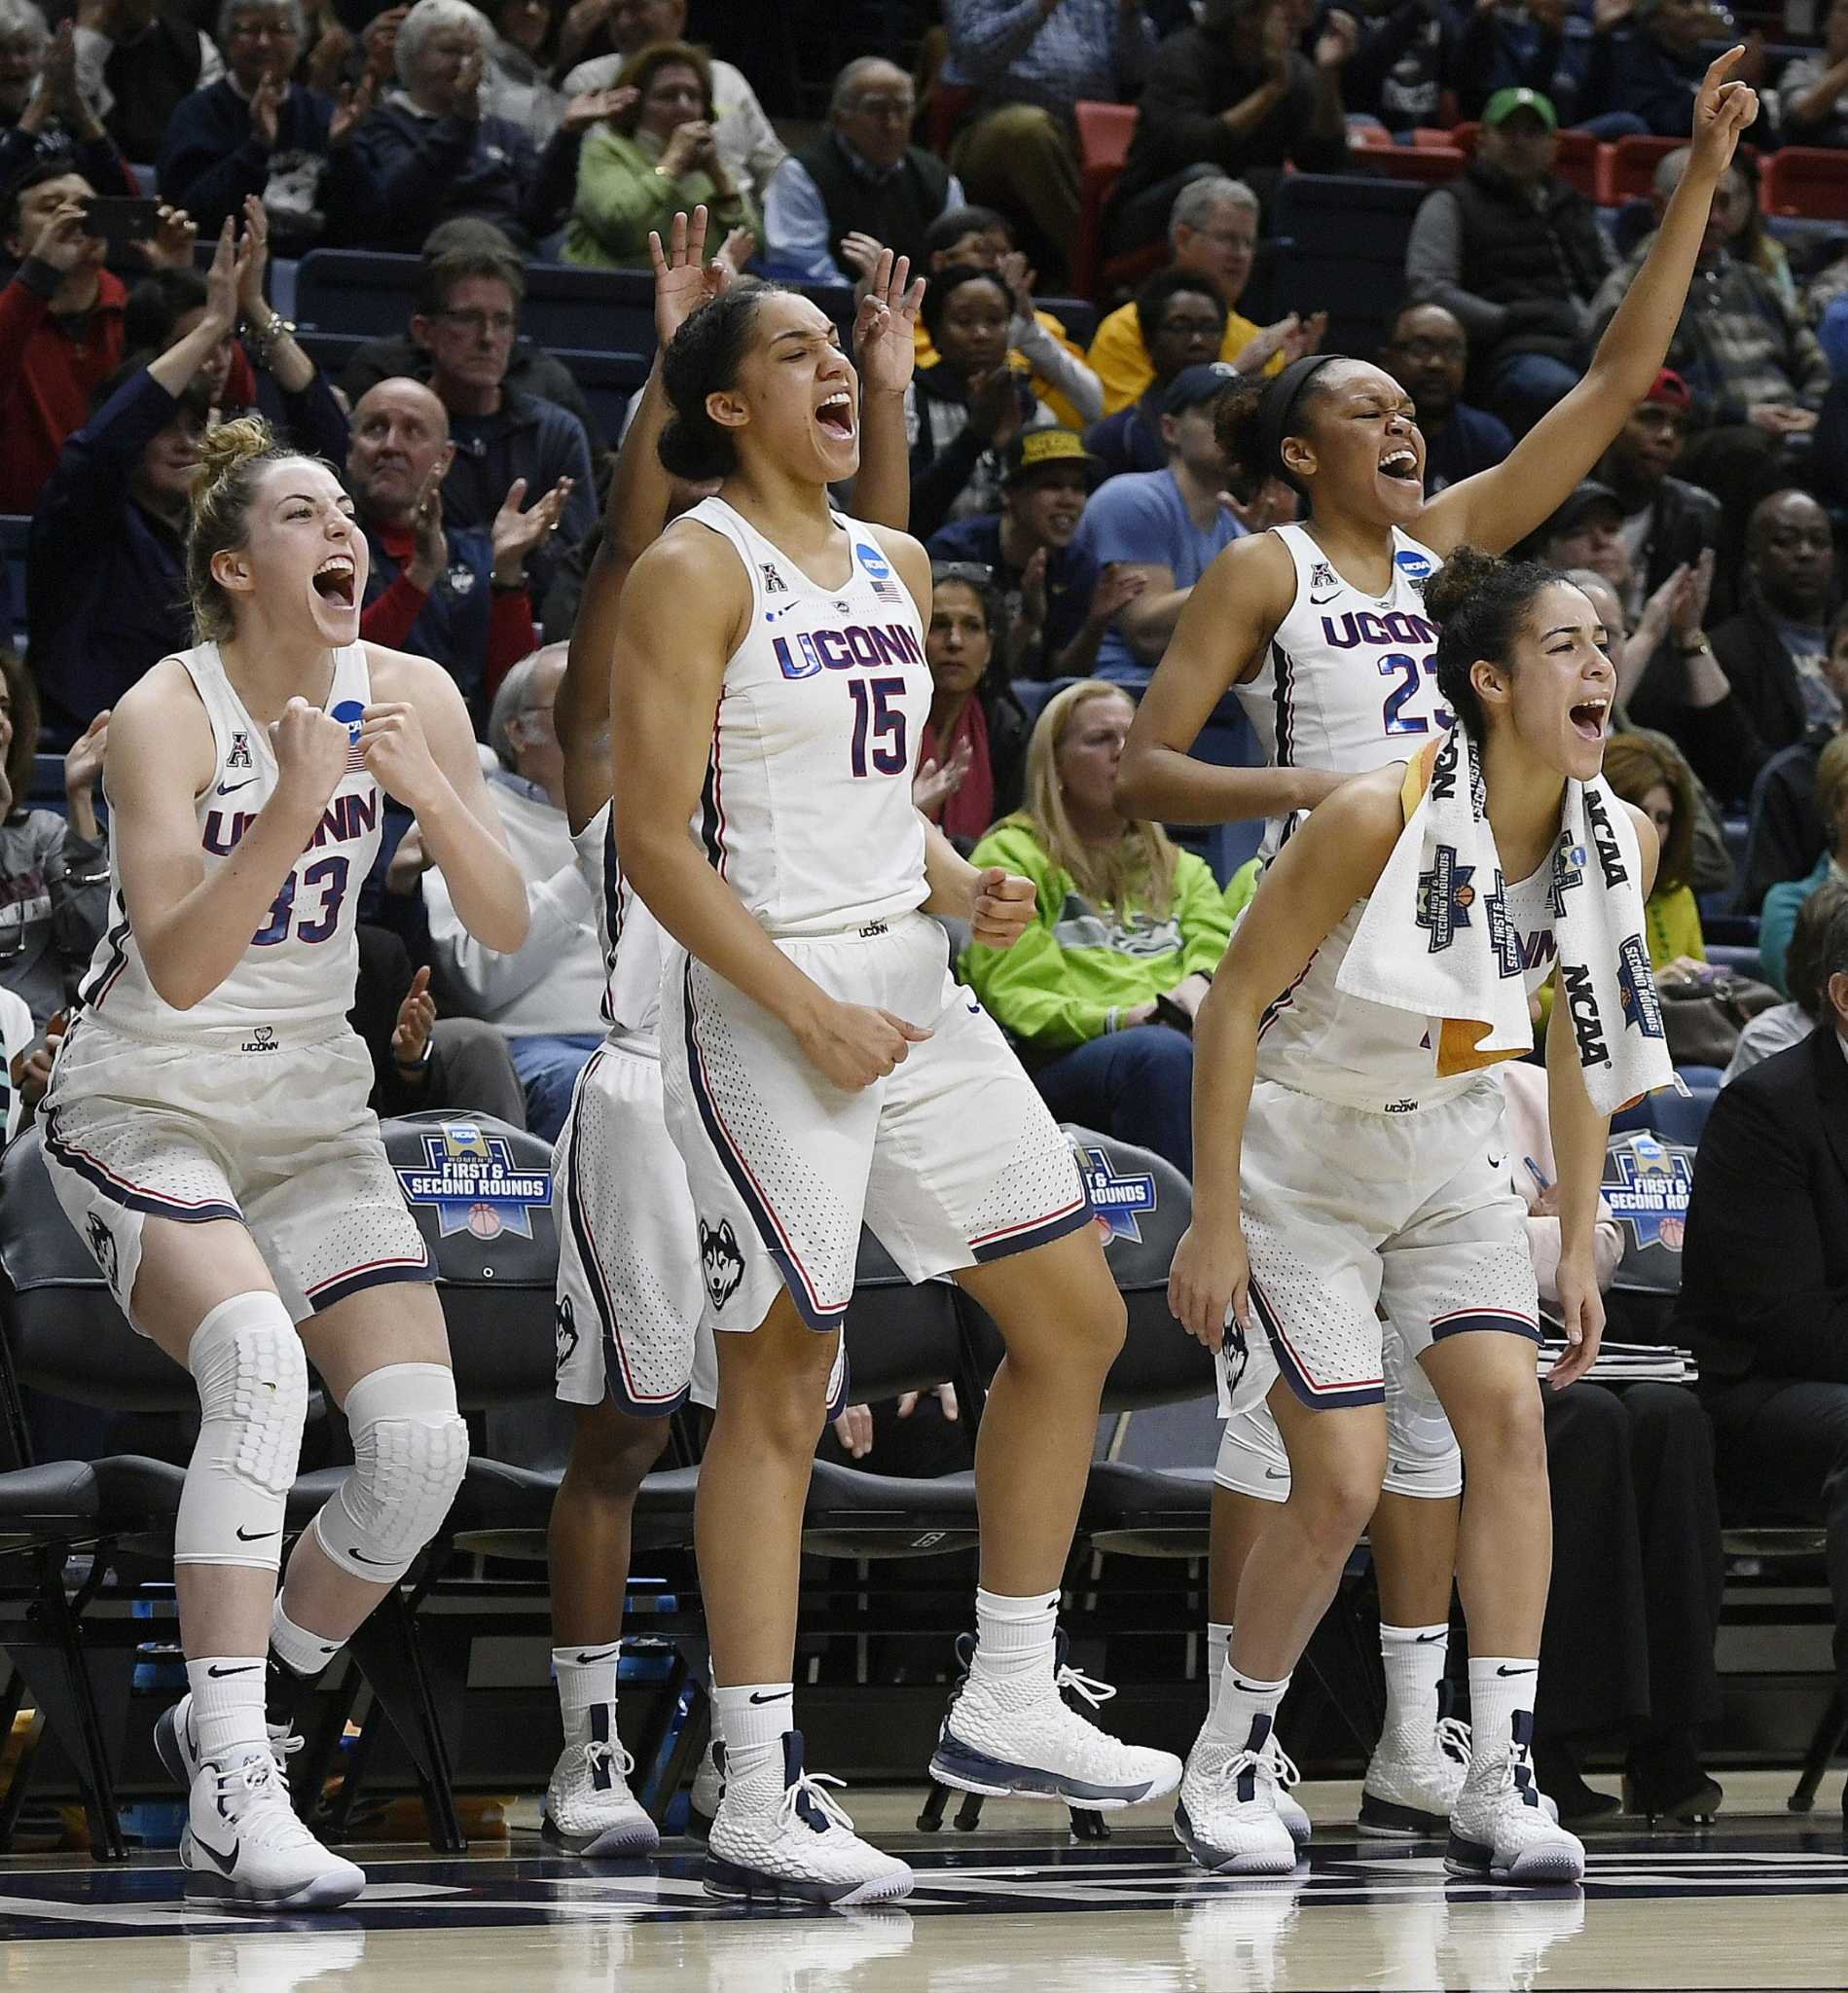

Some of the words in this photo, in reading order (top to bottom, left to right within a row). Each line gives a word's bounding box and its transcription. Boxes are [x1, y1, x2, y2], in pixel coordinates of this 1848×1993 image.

[1321, 610, 1444, 650] UCON
[772, 624, 926, 680] UCONN
[848, 676, 908, 779] 15
[202, 786, 377, 856] UNN
[1584, 789, 1629, 890] NCAA
[1493, 913, 1506, 945] FIRST
[1504, 923, 1519, 968] SECOND
[1624, 946, 1647, 988] SECOND
[1638, 988, 1660, 1033] ROUNDS
[1562, 963, 1610, 1068] NCAA
[241, 1040, 279, 1052] UCONN
[1385, 1101, 1418, 1112] UCONN
[412, 1178, 475, 1196] SECOND
[479, 1178, 545, 1197] ROUNDS
[443, 1162, 489, 1178] FIRST
[491, 1163, 504, 1178] &
[1633, 1178, 1674, 1194] FIRST
[1609, 1193, 1664, 1210] SECOND
